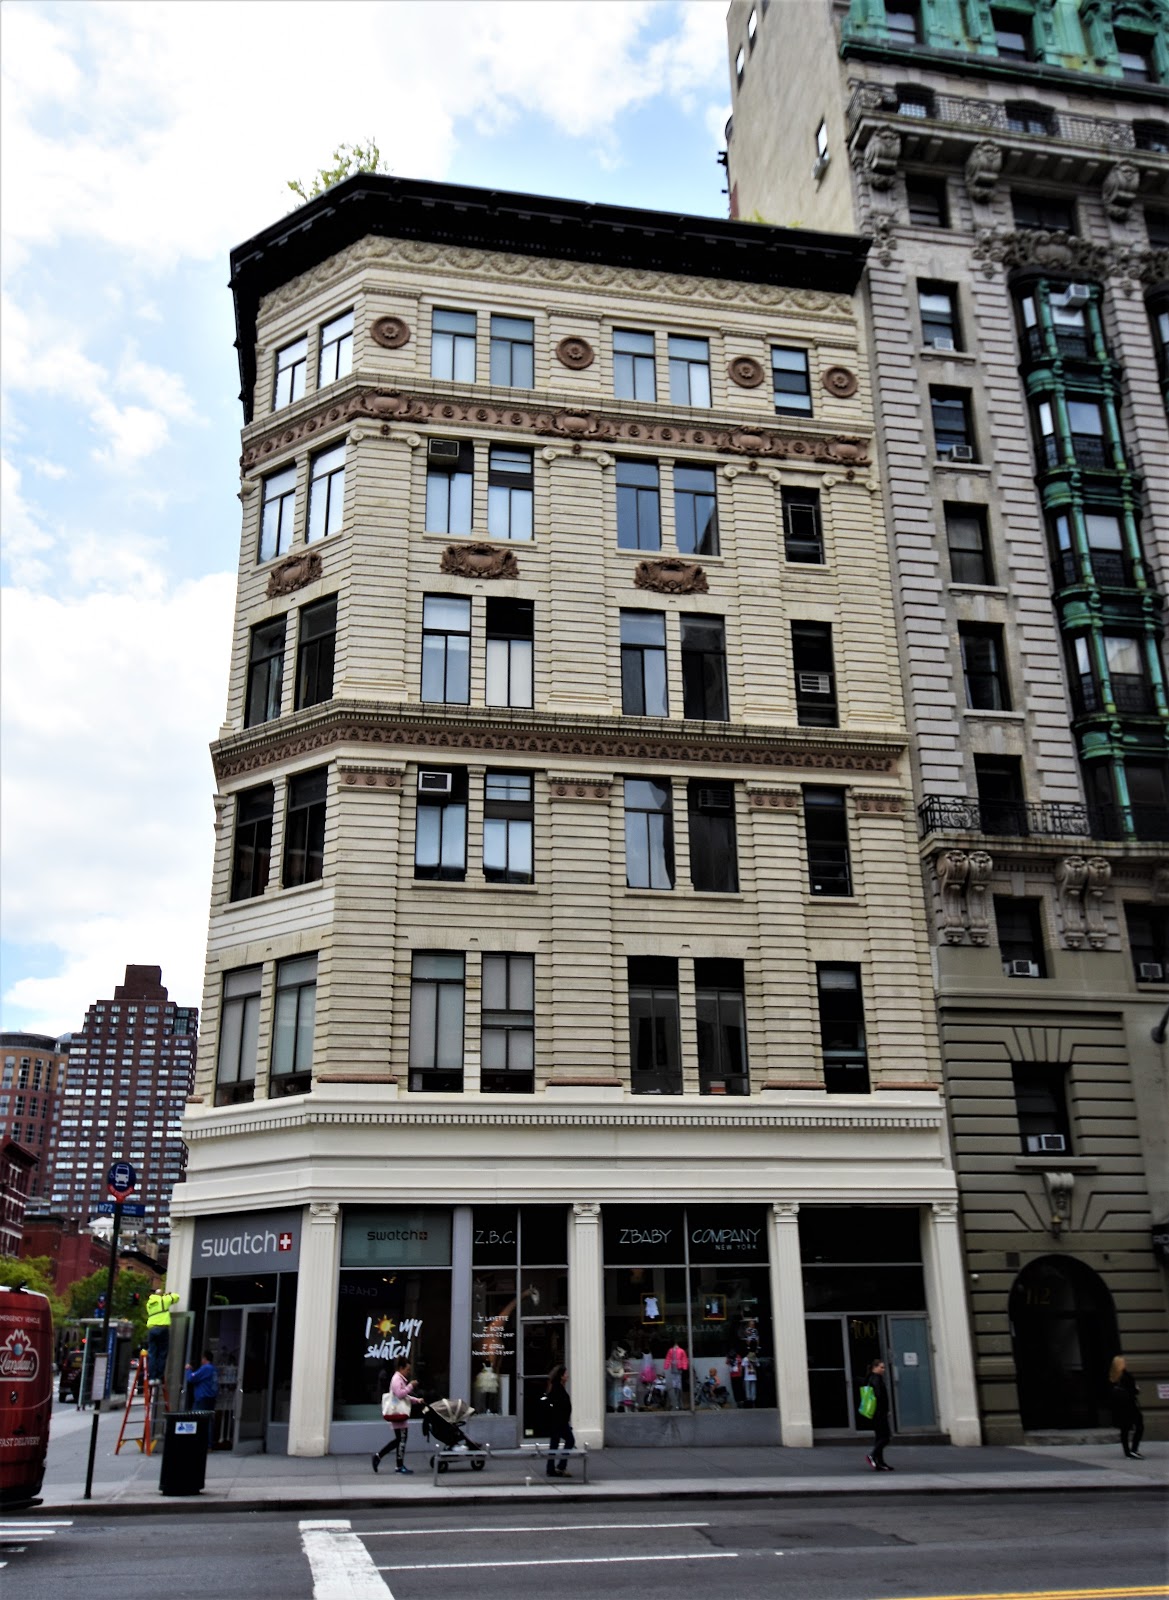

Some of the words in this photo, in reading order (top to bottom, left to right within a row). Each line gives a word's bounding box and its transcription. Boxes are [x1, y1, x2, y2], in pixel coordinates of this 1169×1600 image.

[201, 1230, 277, 1257] swatch
[367, 1230, 418, 1241] swatch
[474, 1230, 516, 1244] Z.B.C.
[619, 1229, 672, 1244] ZBABY
[691, 1228, 762, 1244] COMPANY
[365, 1316, 372, 1340] I
